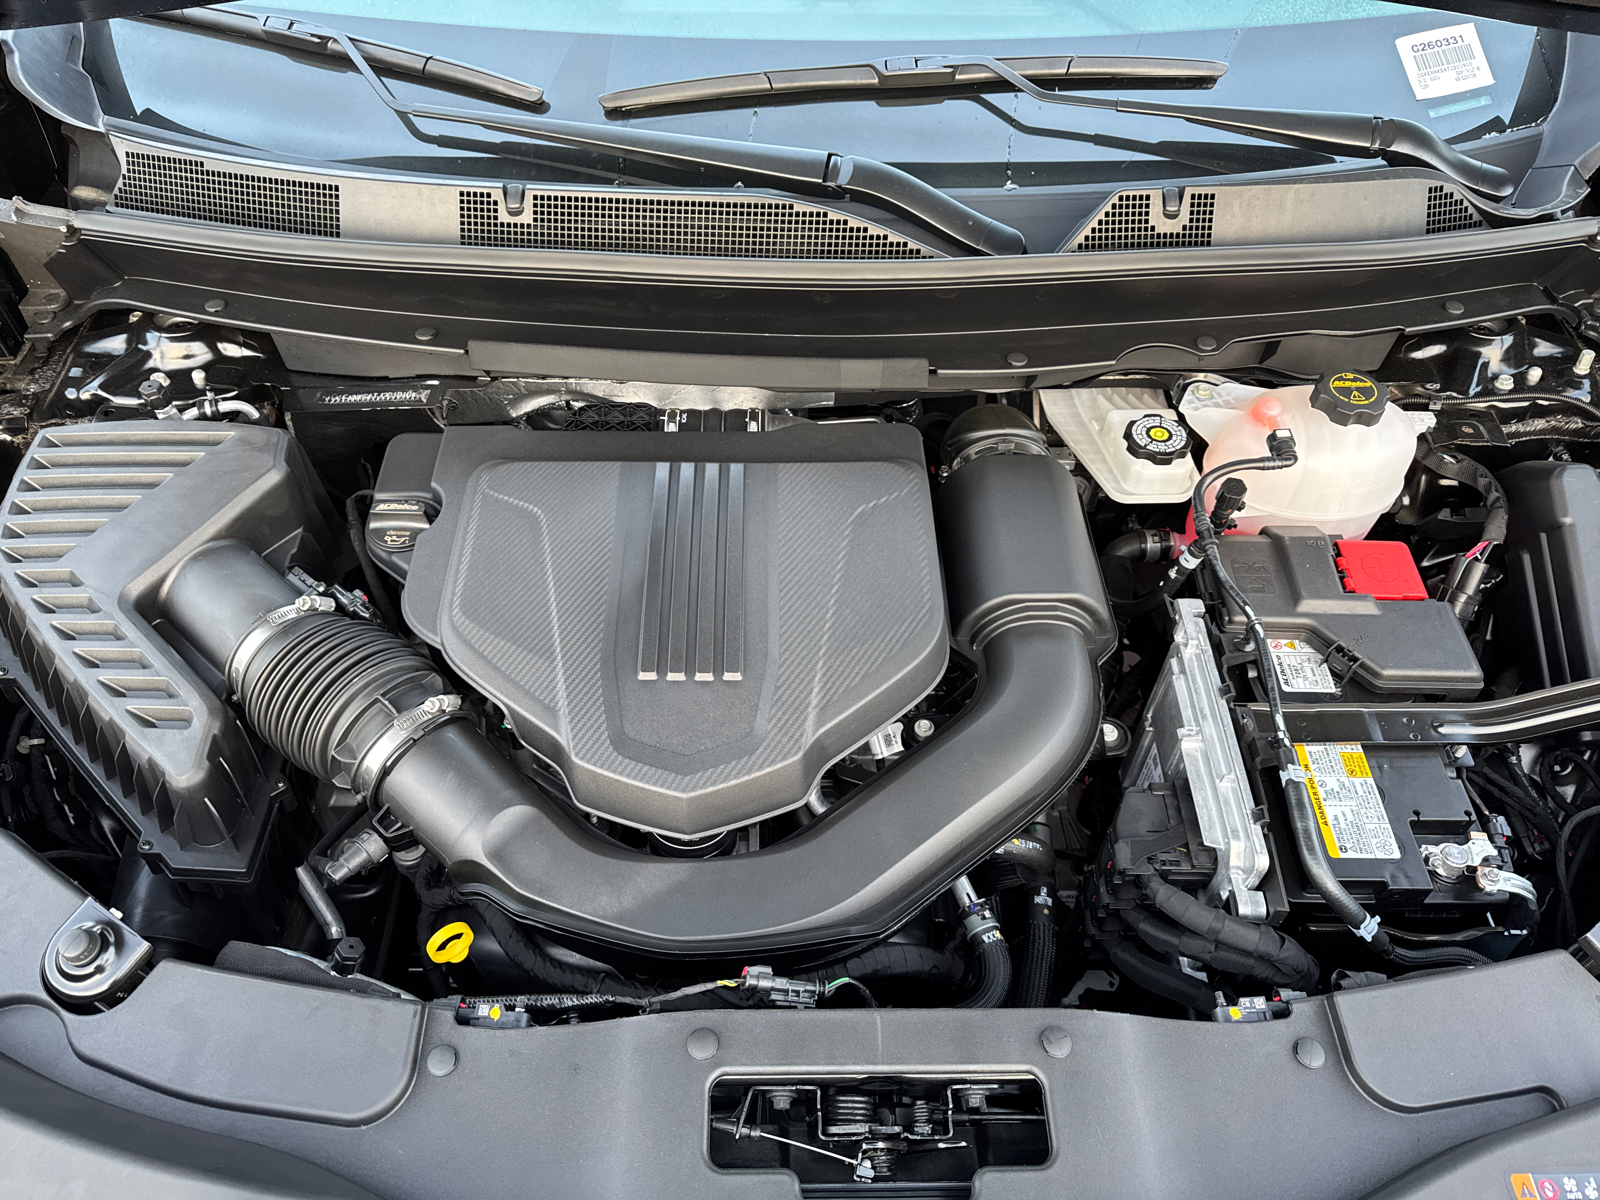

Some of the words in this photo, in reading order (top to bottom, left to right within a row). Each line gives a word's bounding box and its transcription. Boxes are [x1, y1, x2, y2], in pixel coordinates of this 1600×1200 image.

[1411, 34, 1465, 53] G260331
[375, 503, 419, 511] ACDelco
[1275, 654, 1291, 687] ACDelco
[1567, 1191, 1583, 1199] AUTO
